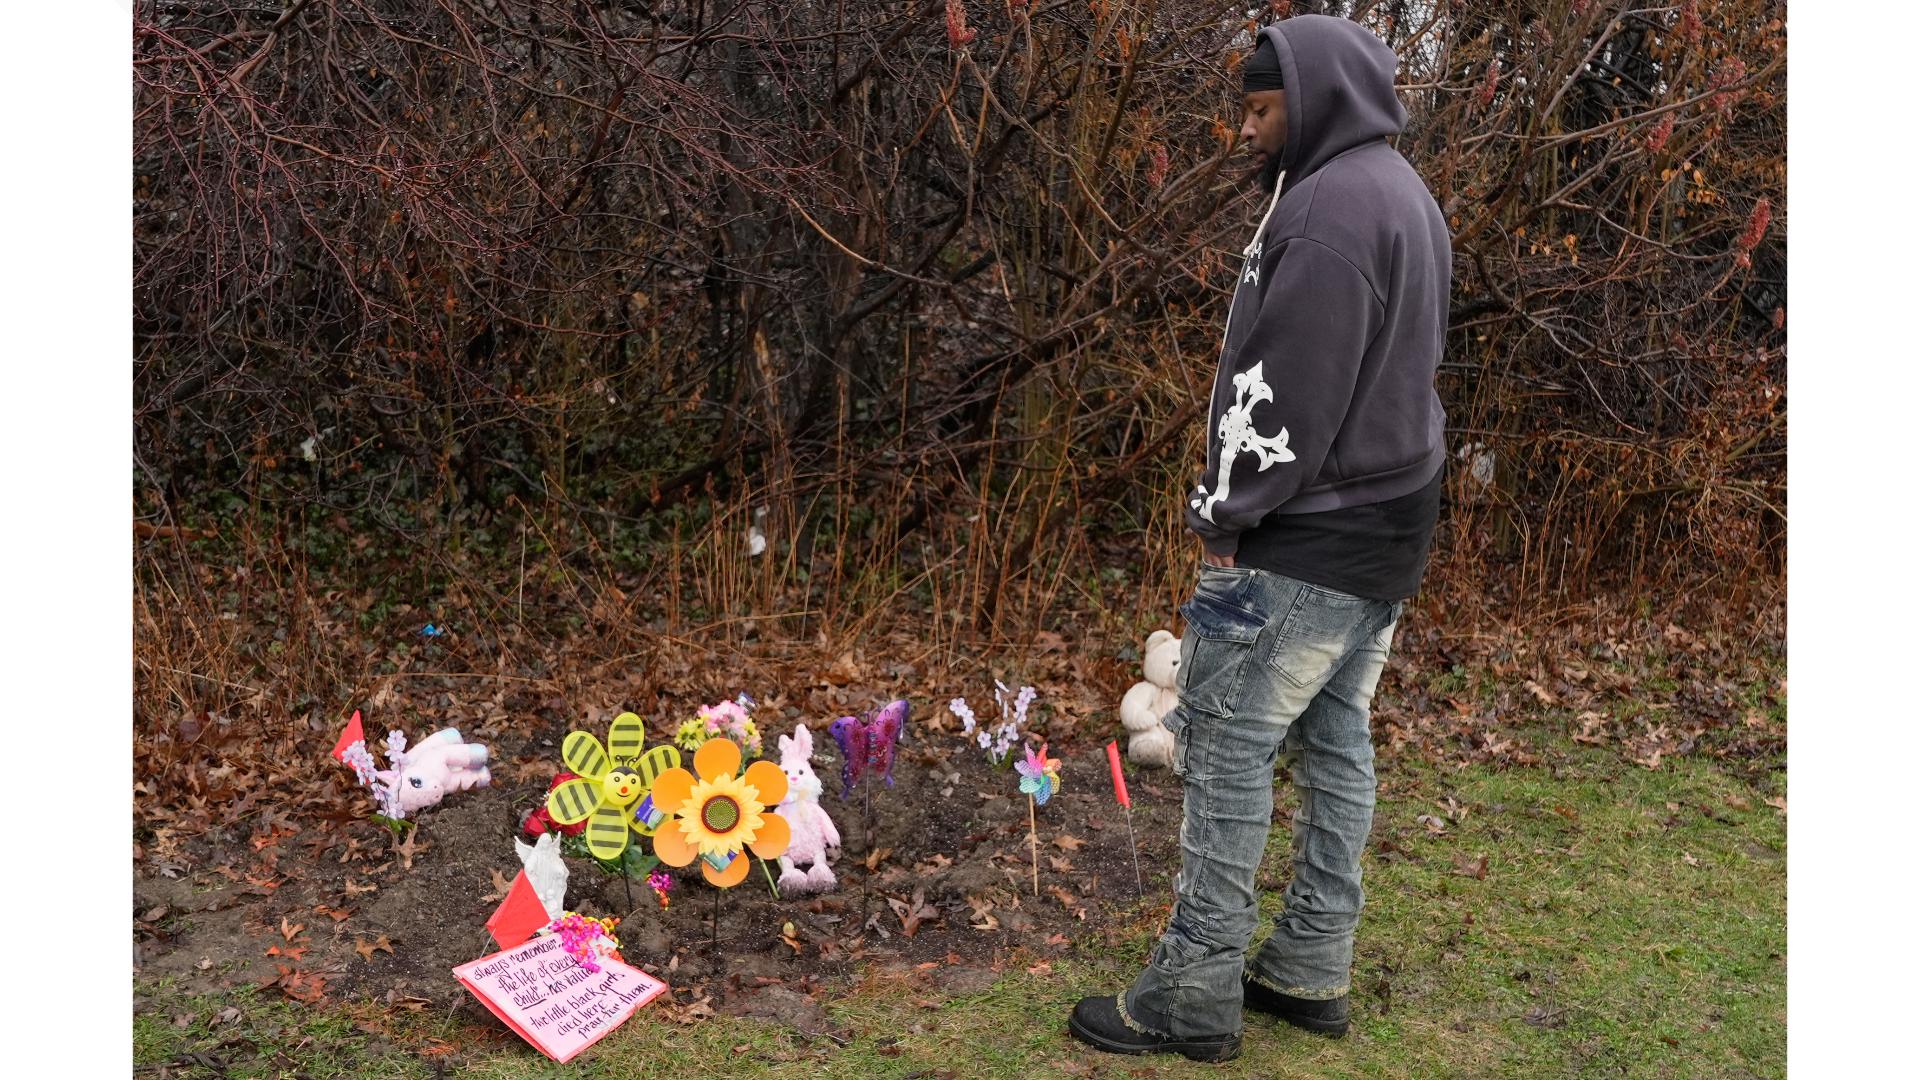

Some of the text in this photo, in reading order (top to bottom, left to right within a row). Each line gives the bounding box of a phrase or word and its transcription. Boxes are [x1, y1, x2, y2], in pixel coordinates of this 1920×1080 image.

[497, 976, 520, 995] the
[513, 968, 537, 986] life
[543, 980, 568, 995] has
[544, 1003, 570, 1022] little
[566, 988, 607, 1010] black
[557, 998, 608, 1036] died here
[578, 1016, 605, 1039] pray
[601, 1003, 620, 1018] for
